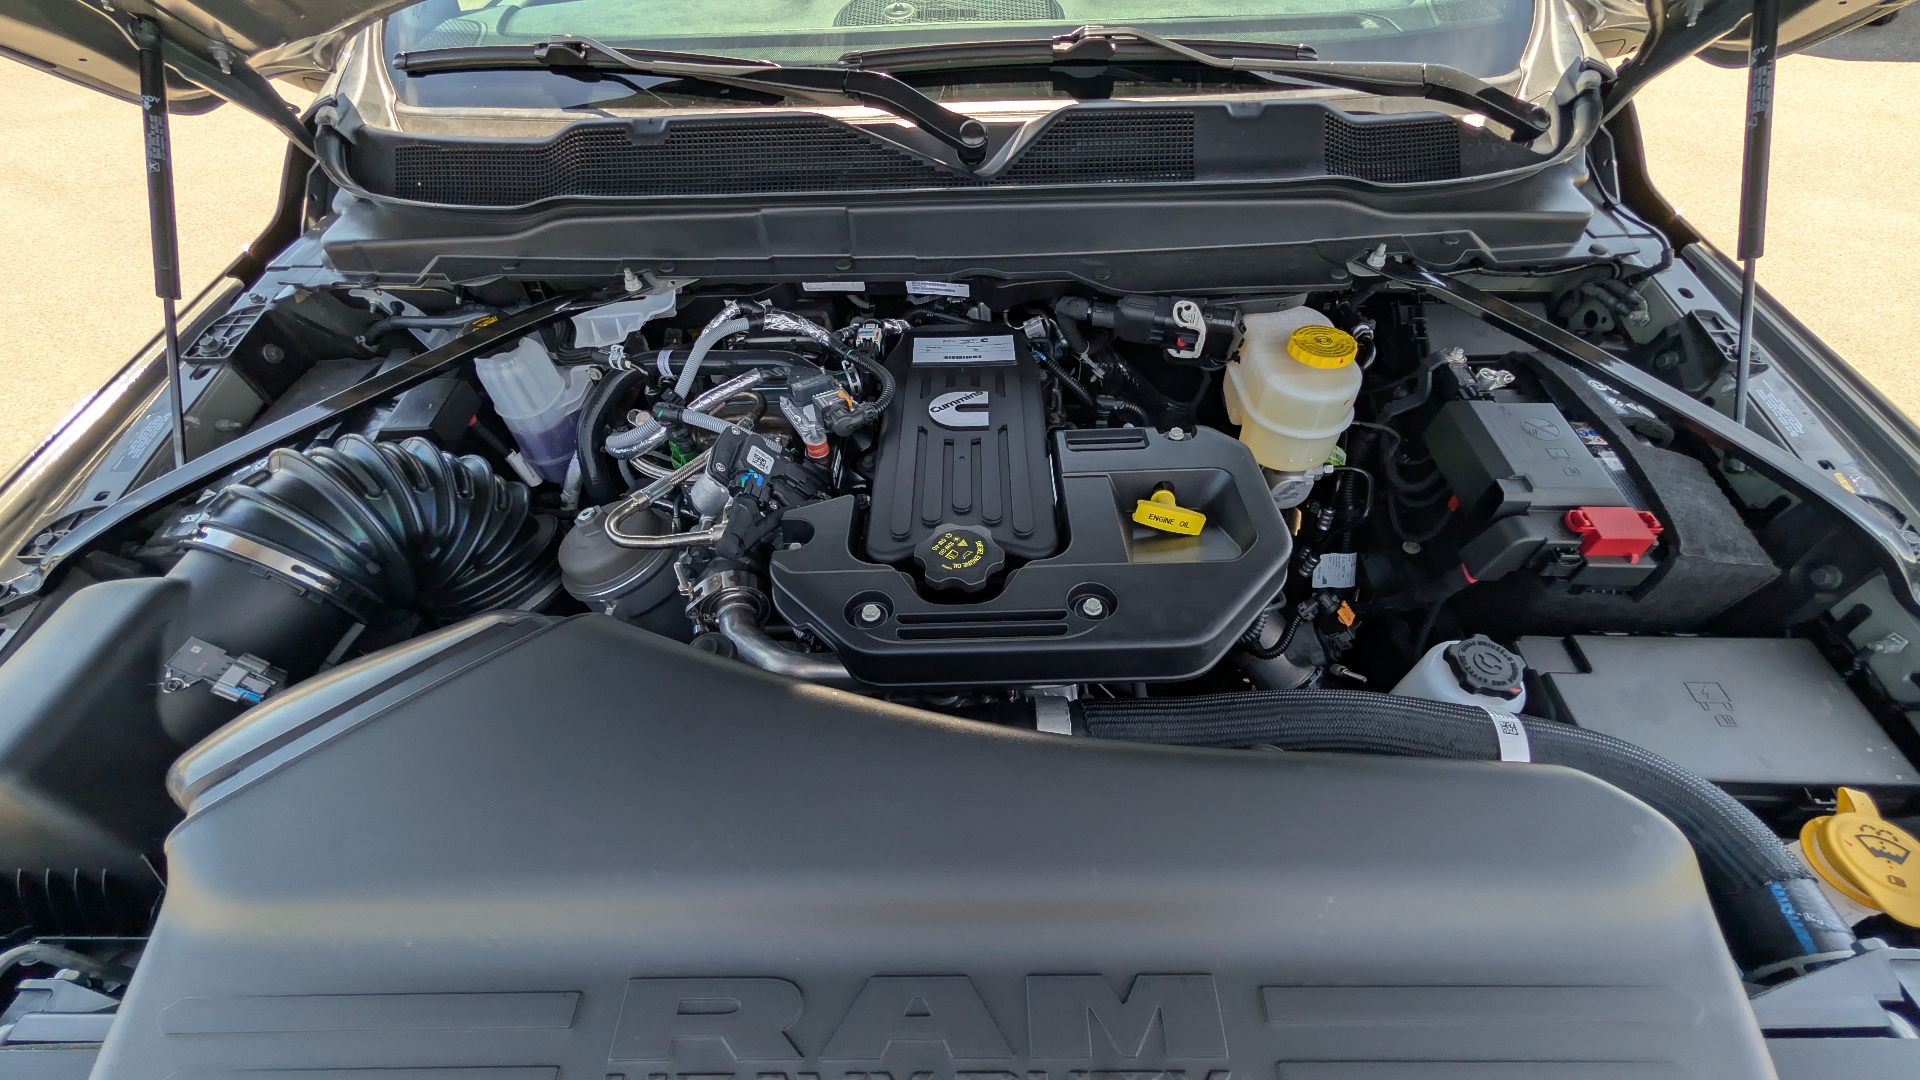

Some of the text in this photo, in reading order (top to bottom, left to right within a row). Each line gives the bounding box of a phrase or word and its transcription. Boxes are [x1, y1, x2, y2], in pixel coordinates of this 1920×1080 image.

[930, 391, 984, 413] Cummins
[1148, 513, 1190, 529] ENGINE OIL
[608, 972, 1229, 1061] RAM
